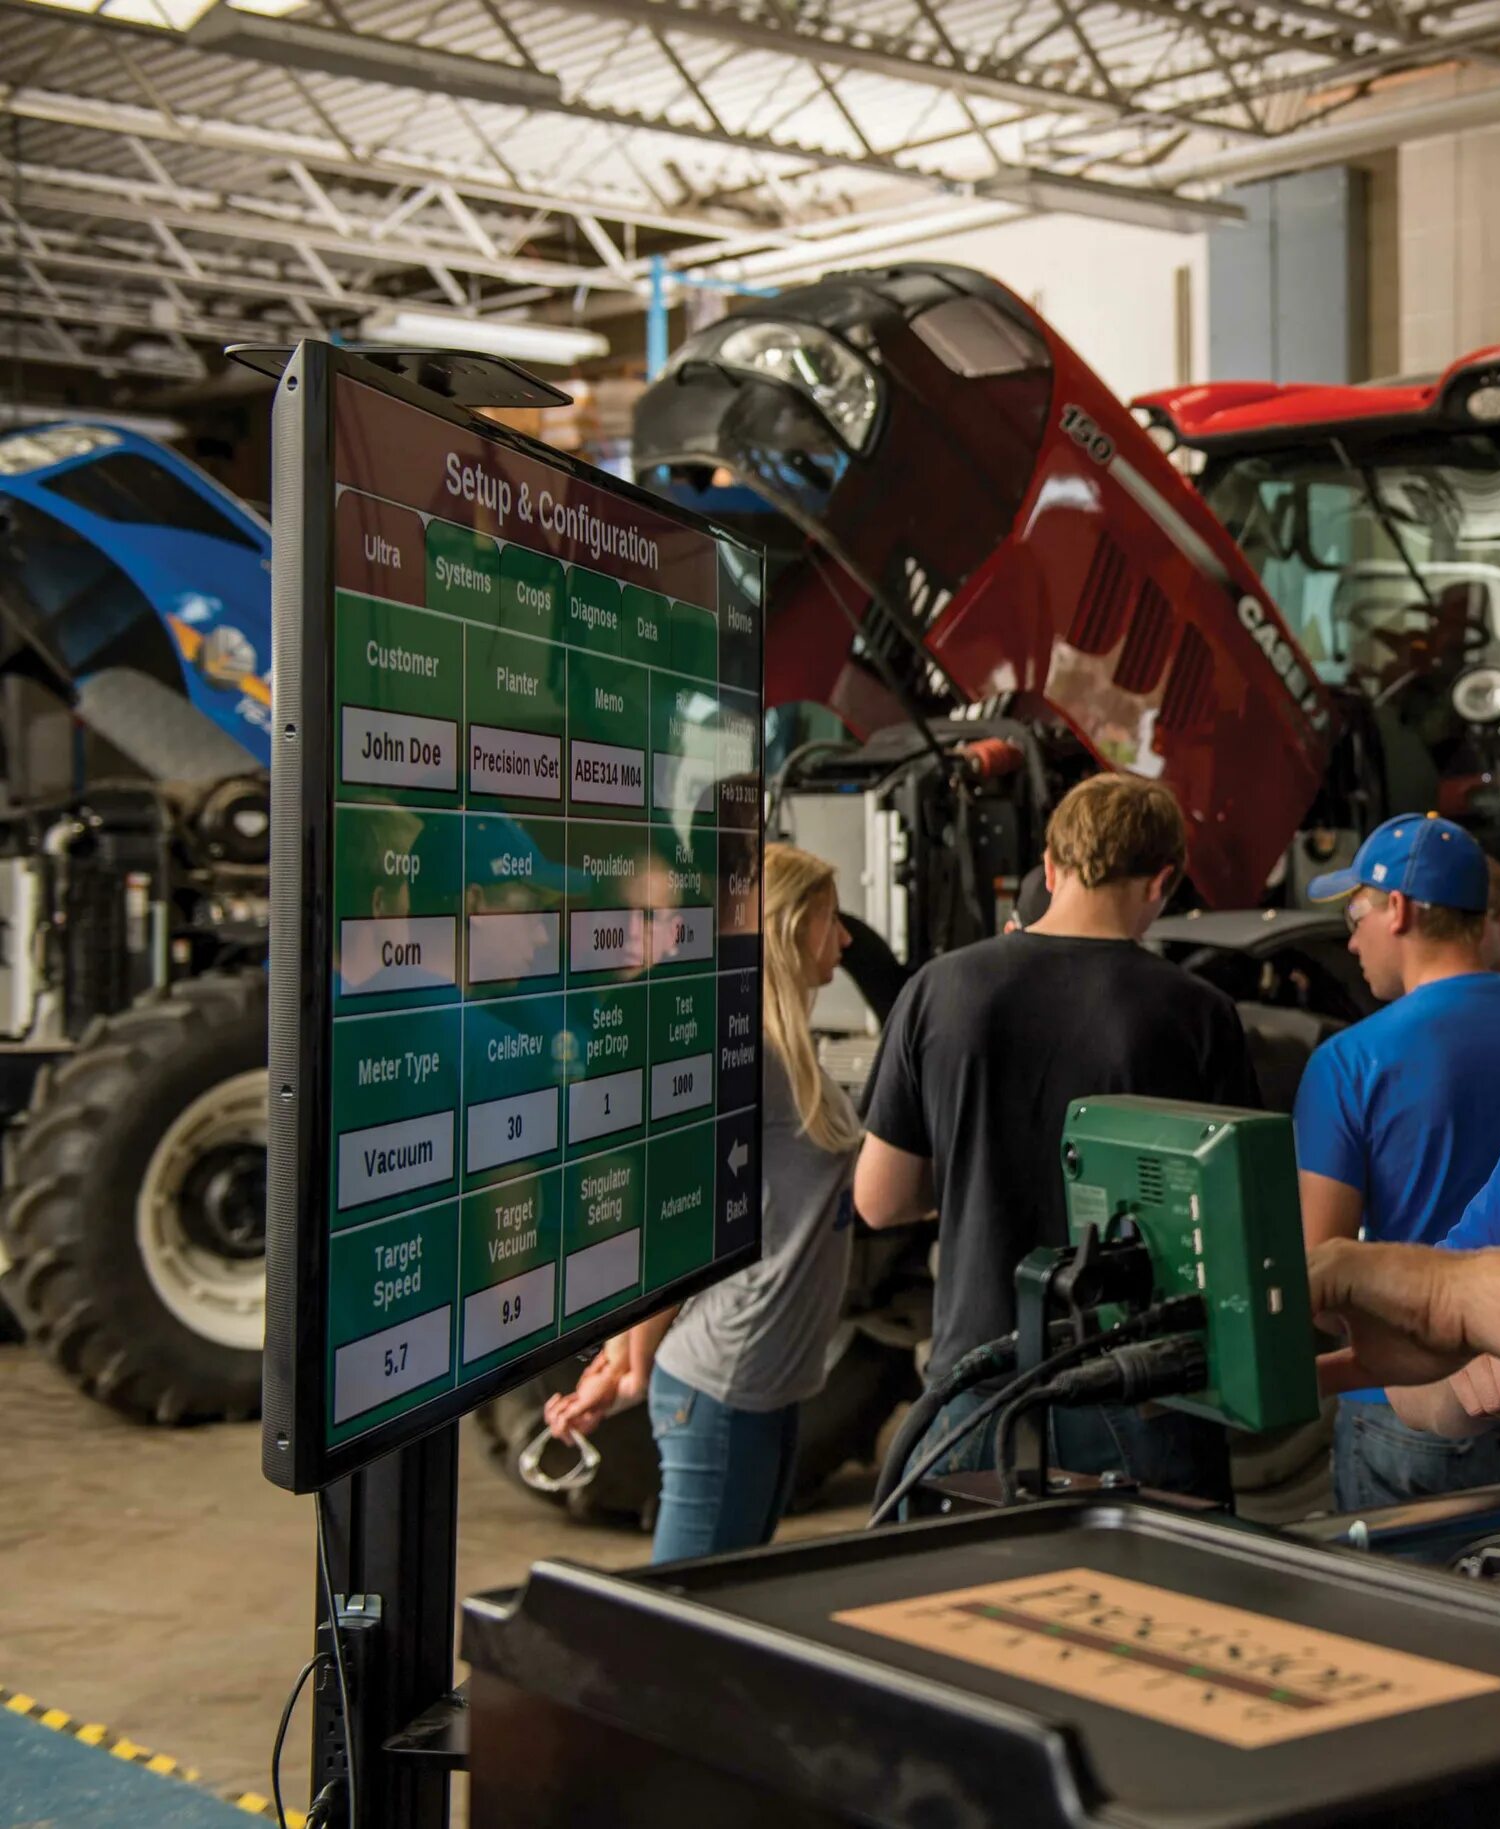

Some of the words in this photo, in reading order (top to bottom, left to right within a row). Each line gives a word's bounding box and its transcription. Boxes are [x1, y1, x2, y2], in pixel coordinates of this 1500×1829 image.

[1061, 403, 1115, 464] 150
[445, 452, 511, 526] Setup
[517, 482, 533, 524] &
[538, 491, 660, 570] Configuration
[365, 535, 401, 569] Ultra
[435, 556, 491, 594] Systems
[517, 581, 551, 616] Crops
[570, 597, 617, 630] Diagnose
[637, 617, 658, 641] Data
[728, 606, 752, 635] Home
[366, 640, 439, 677] Customer
[1238, 595, 1307, 699] CASE
[497, 667, 539, 697] Planter
[595, 688, 624, 713] Memo
[362, 732, 404, 762] John
[410, 737, 441, 766] Doe
[473, 746, 531, 778] Precision
[534, 751, 559, 779] vSet
[575, 759, 618, 787] ABE314
[621, 765, 642, 788] M04
[721, 784, 735, 802] Feb
[384, 851, 420, 884] Crop
[502, 853, 532, 877] Seed
[583, 854, 634, 884] Population
[675, 844, 694, 864] Row
[668, 868, 701, 895] Spacing
[728, 873, 751, 896] Clear
[733, 902, 746, 927] All
[593, 928, 624, 951] 30000
[675, 923, 685, 945] 30
[686, 925, 695, 943] in
[382, 941, 421, 967] Corn
[592, 1006, 623, 1030] Seeds
[675, 996, 693, 1017] Test
[669, 1017, 697, 1045] Length
[728, 1015, 749, 1038] Print
[488, 1033, 543, 1063] Cells/Rev
[586, 1037, 603, 1063] per
[605, 1032, 629, 1057] Drop
[721, 1046, 755, 1073] Preview
[358, 1057, 401, 1087] Meter
[405, 1050, 440, 1083] Type
[672, 1072, 693, 1097] 1000
[603, 1093, 611, 1116] 1
[507, 1115, 522, 1140] 30
[364, 1137, 433, 1178] Vacuum
[580, 1166, 631, 1202] Singulator
[495, 1199, 533, 1232] Target
[588, 1199, 622, 1226] Setting
[660, 1186, 701, 1221] Advanced
[726, 1193, 749, 1223] Back
[375, 1234, 423, 1273] Target
[488, 1228, 537, 1265] Vacuum
[373, 1265, 422, 1313] Speed
[502, 1296, 521, 1325] 9.9
[384, 1342, 408, 1377] 5.7
